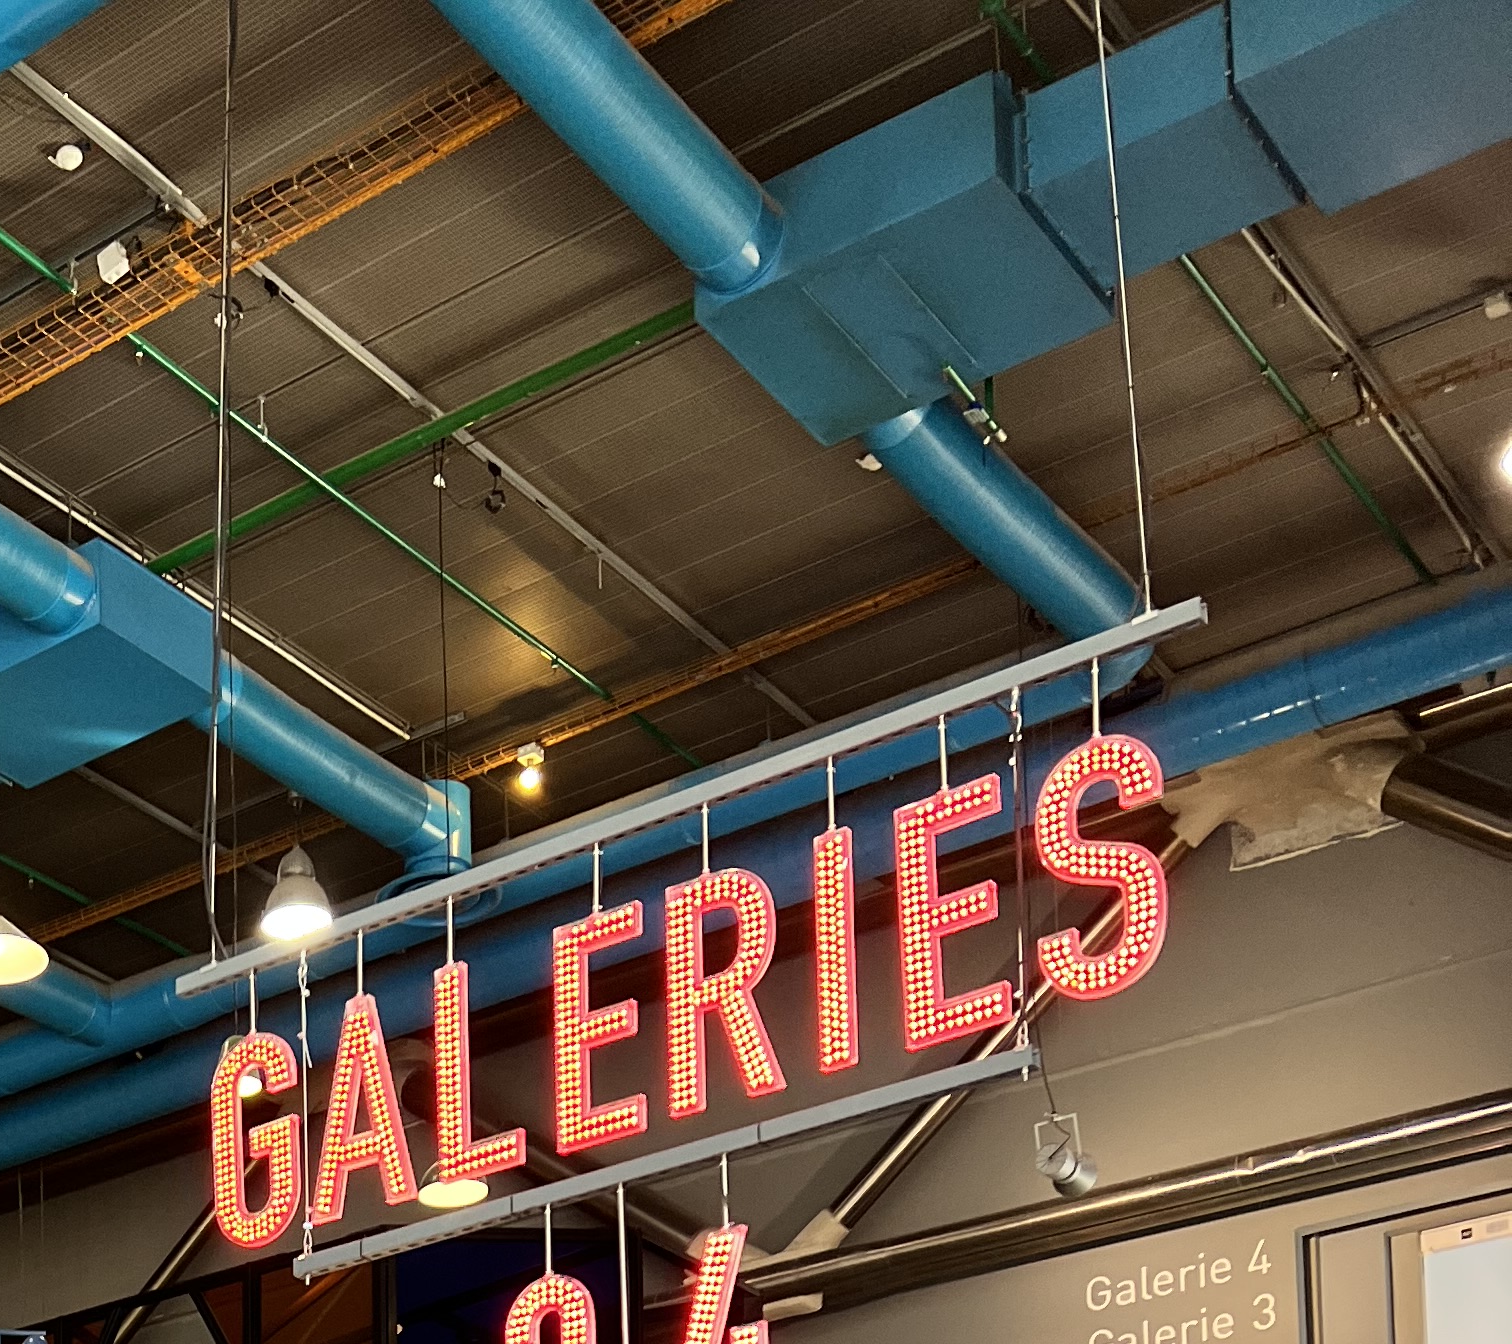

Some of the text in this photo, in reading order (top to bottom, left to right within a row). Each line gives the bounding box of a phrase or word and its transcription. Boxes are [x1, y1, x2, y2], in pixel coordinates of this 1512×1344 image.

[209, 734, 1169, 1249] GALERIES
[1086, 1238, 1272, 1311] Galerie 4
[1252, 1293, 1276, 1330] 3
